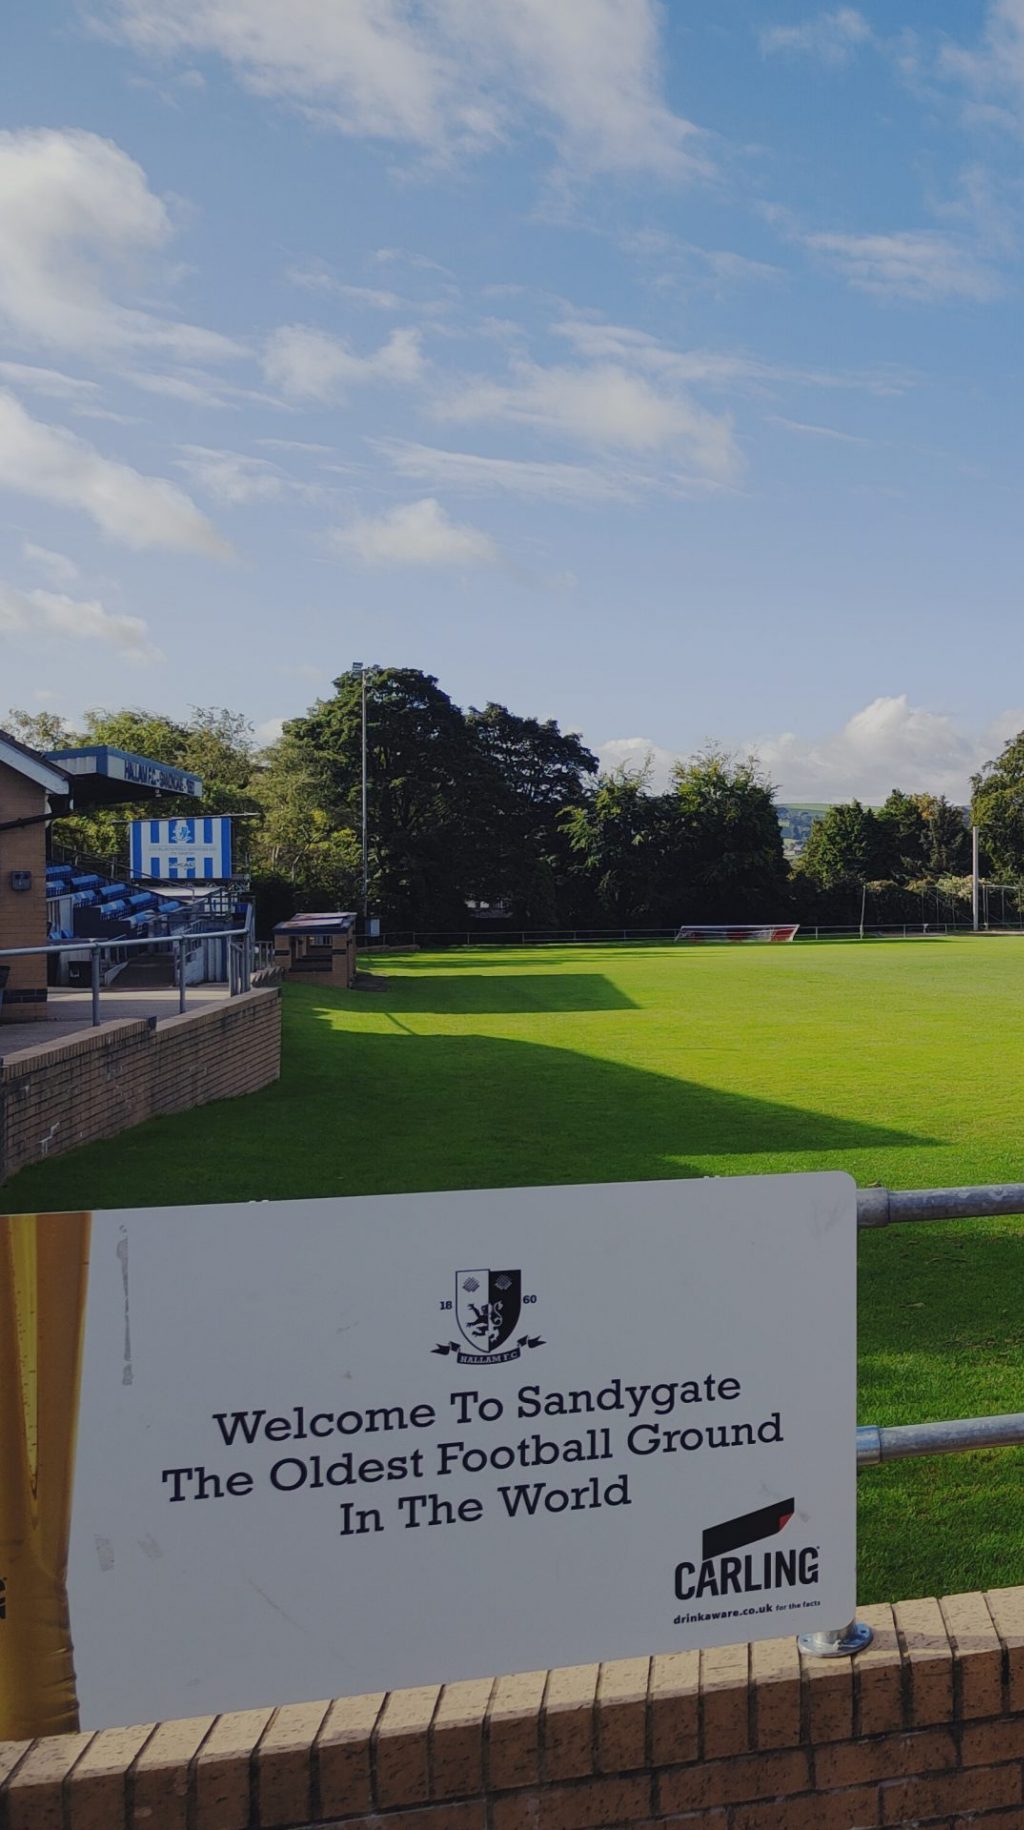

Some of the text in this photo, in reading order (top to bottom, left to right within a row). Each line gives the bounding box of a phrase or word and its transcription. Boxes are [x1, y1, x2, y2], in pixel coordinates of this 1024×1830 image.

[439, 1294, 537, 1311] 18 60
[460, 1354, 501, 1364] HALLAM
[212, 1373, 742, 1446] Welcome To Sandygate
[162, 1412, 784, 1502] The Oldest Football Ground
[339, 1474, 632, 1536] In The World
[674, 1546, 819, 1601] CARLING
[673, 1600, 821, 1625] drinkaware.co.uk for the facts
